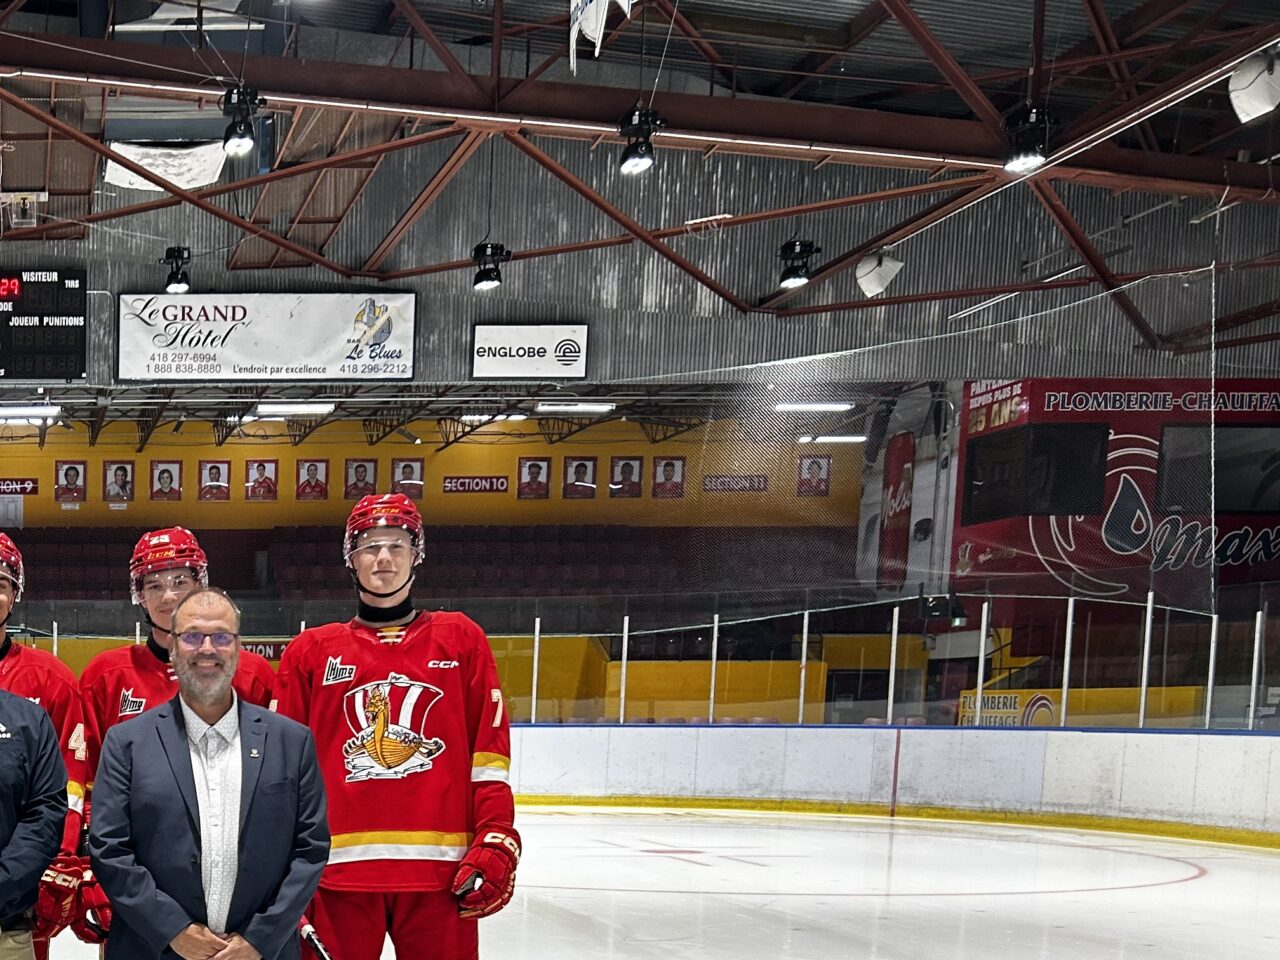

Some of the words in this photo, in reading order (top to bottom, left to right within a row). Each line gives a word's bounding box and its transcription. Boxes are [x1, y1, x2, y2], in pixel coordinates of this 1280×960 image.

[22, 272, 58, 282] VISITEUR
[65, 280, 80, 288] TIRS
[123, 296, 160, 328] Le
[161, 304, 248, 322] GRAND
[9, 317, 39, 327] JOUEUR
[43, 317, 85, 327] PUNITIONS
[152, 319, 251, 350] Hôtel
[345, 344, 364, 360] Le
[368, 343, 403, 360] Blues
[149, 353, 169, 363] 418
[170, 353, 217, 364] 297-6994
[152, 364, 173, 374] 888
[175, 364, 222, 374] 838-8880
[233, 365, 268, 374] L'endroit
[269, 366, 283, 376] par
[285, 364, 327, 374] excellence
[339, 365, 359, 374] 418
[360, 364, 408, 374] 296-2212
[24, 480, 34, 493] 9
[444, 478, 490, 491] SECTION
[491, 478, 507, 490] 10
[961, 714, 1018, 726] CHUFFAGE
